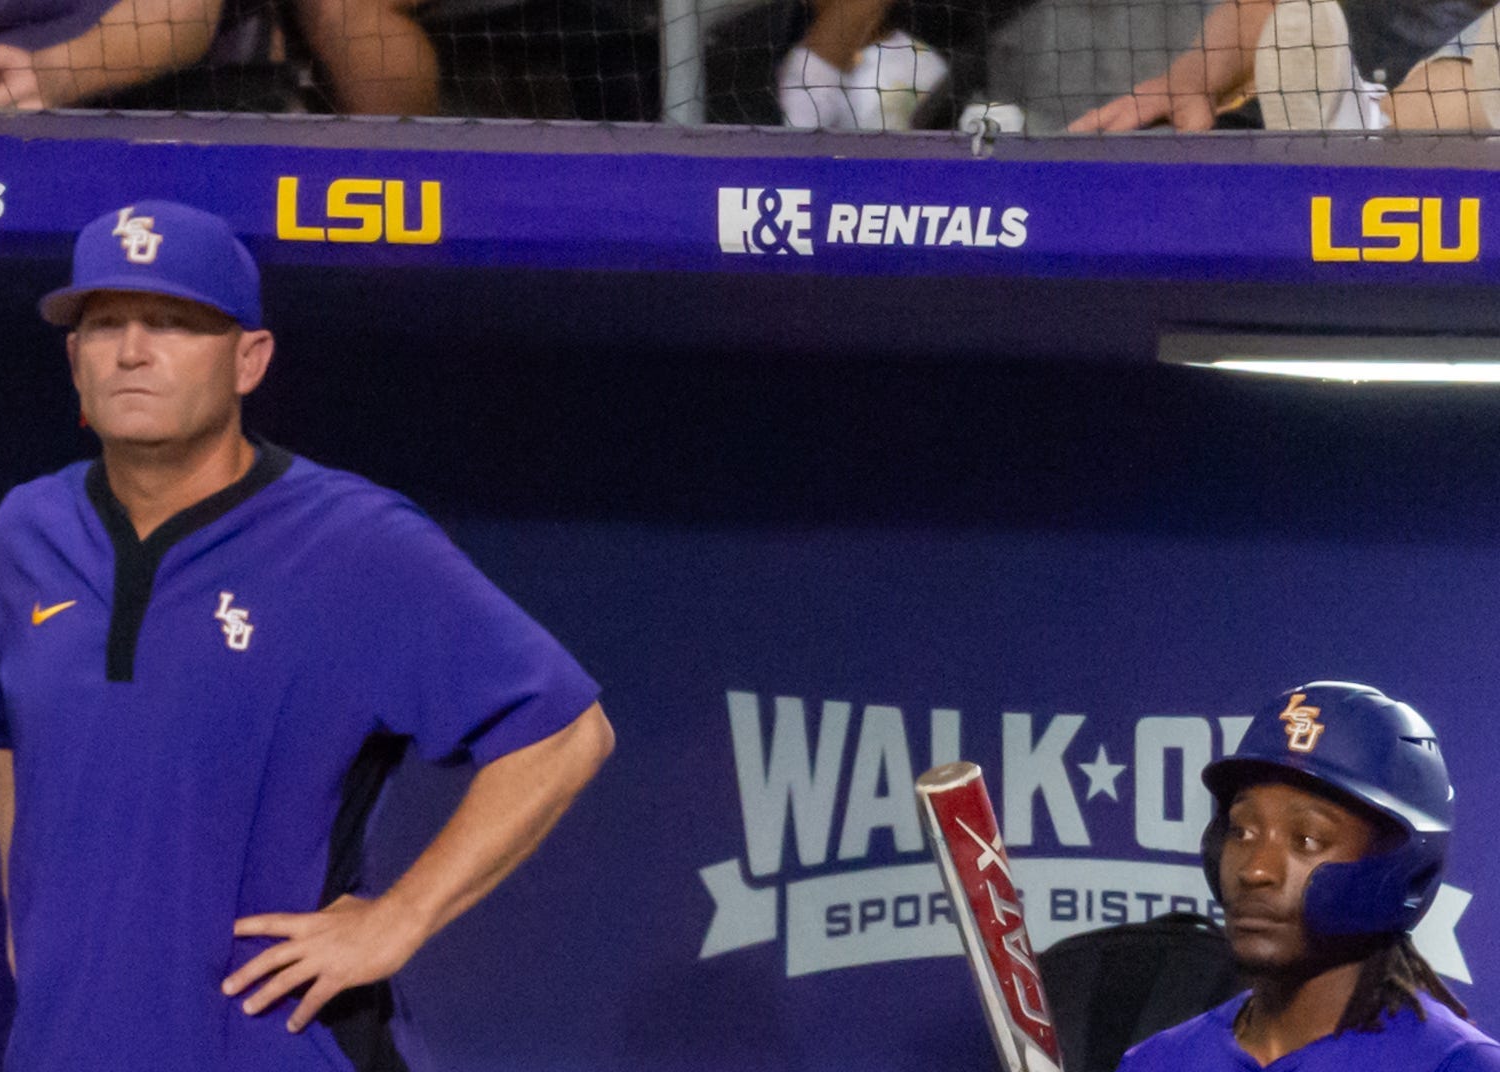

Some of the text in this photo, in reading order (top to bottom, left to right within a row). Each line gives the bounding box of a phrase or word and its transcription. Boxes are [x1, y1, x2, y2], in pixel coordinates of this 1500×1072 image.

[112, 207, 163, 263] LSU
[277, 177, 442, 245] LSU
[718, 187, 1029, 256] H&E RENTALS
[1310, 196, 1480, 262] LSU
[214, 591, 254, 651] LSU
[1279, 693, 1325, 753] LSU
